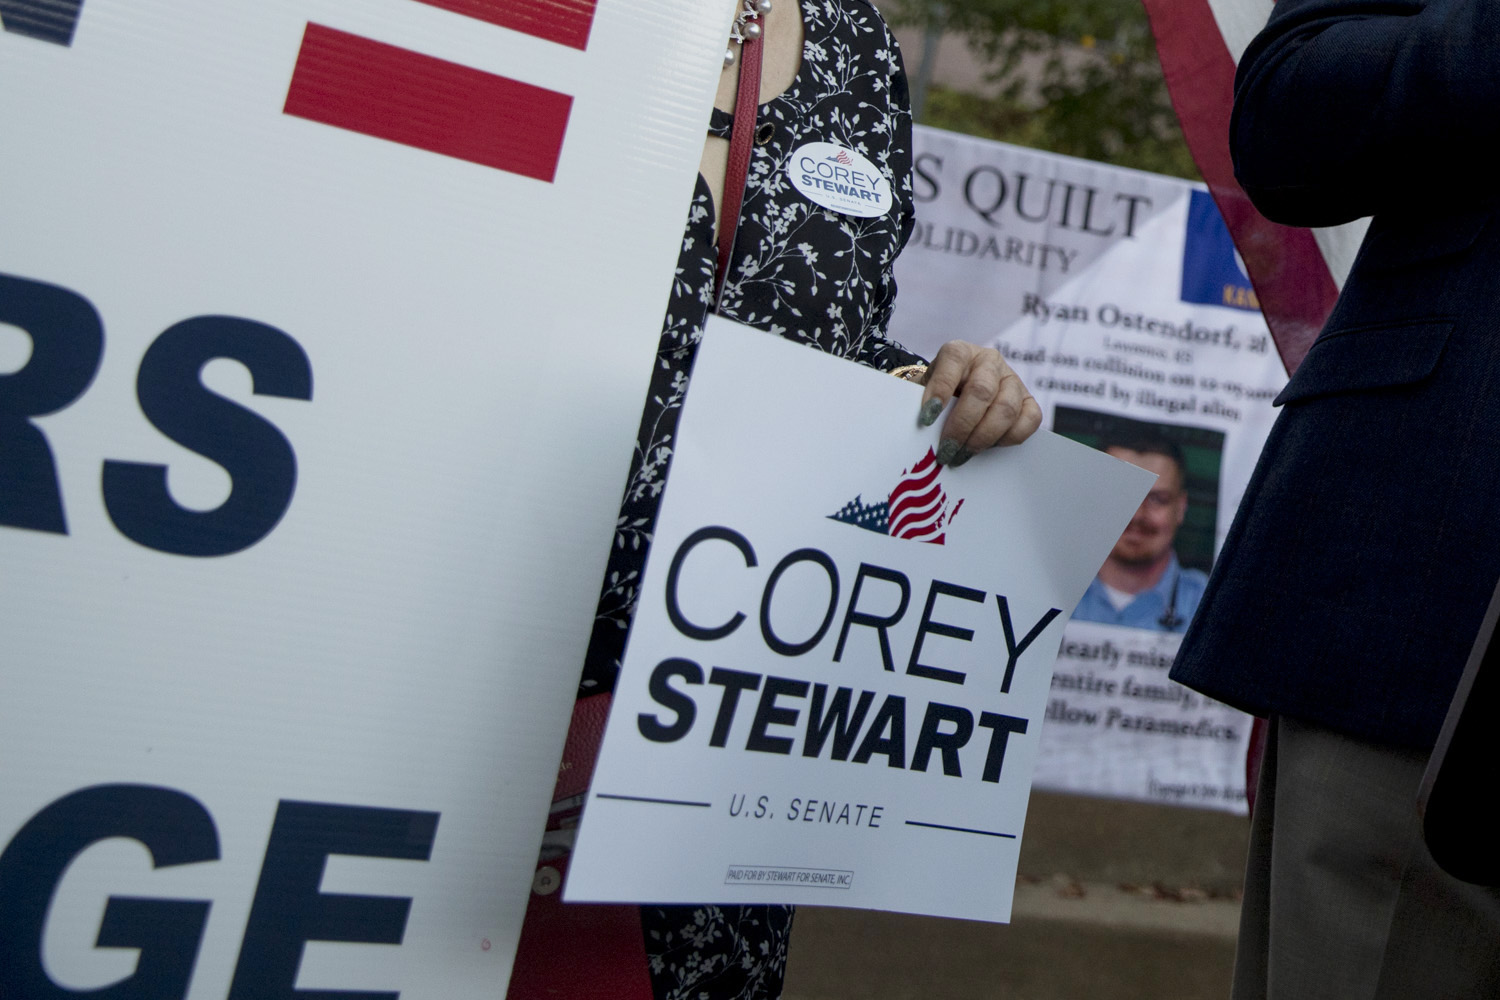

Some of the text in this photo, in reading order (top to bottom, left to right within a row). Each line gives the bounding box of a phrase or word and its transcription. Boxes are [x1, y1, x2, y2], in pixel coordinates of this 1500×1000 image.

[800, 156, 881, 190] COREY
[801, 174, 882, 203] STEWART
[962, 164, 1153, 239] QUILT
[1021, 293, 1089, 326] Ryan
[1098, 303, 1241, 350] Ostendorf,
[1083, 353, 1165, 383] collision
[1035, 375, 1106, 398] caused
[1110, 382, 1130, 406] by
[1135, 387, 1197, 415] illegal
[665, 525, 1063, 695] COREY
[637, 657, 1029, 784] STEWART
[729, 794, 884, 828] U.S. SENATE
[727, 868, 744, 881] PAID
[744, 869, 757, 881] FOR
[757, 870, 767, 881] BY
[766, 870, 797, 882] STEWART
[797, 871, 811, 883] FOR
[811, 872, 836, 885] SENATE,
